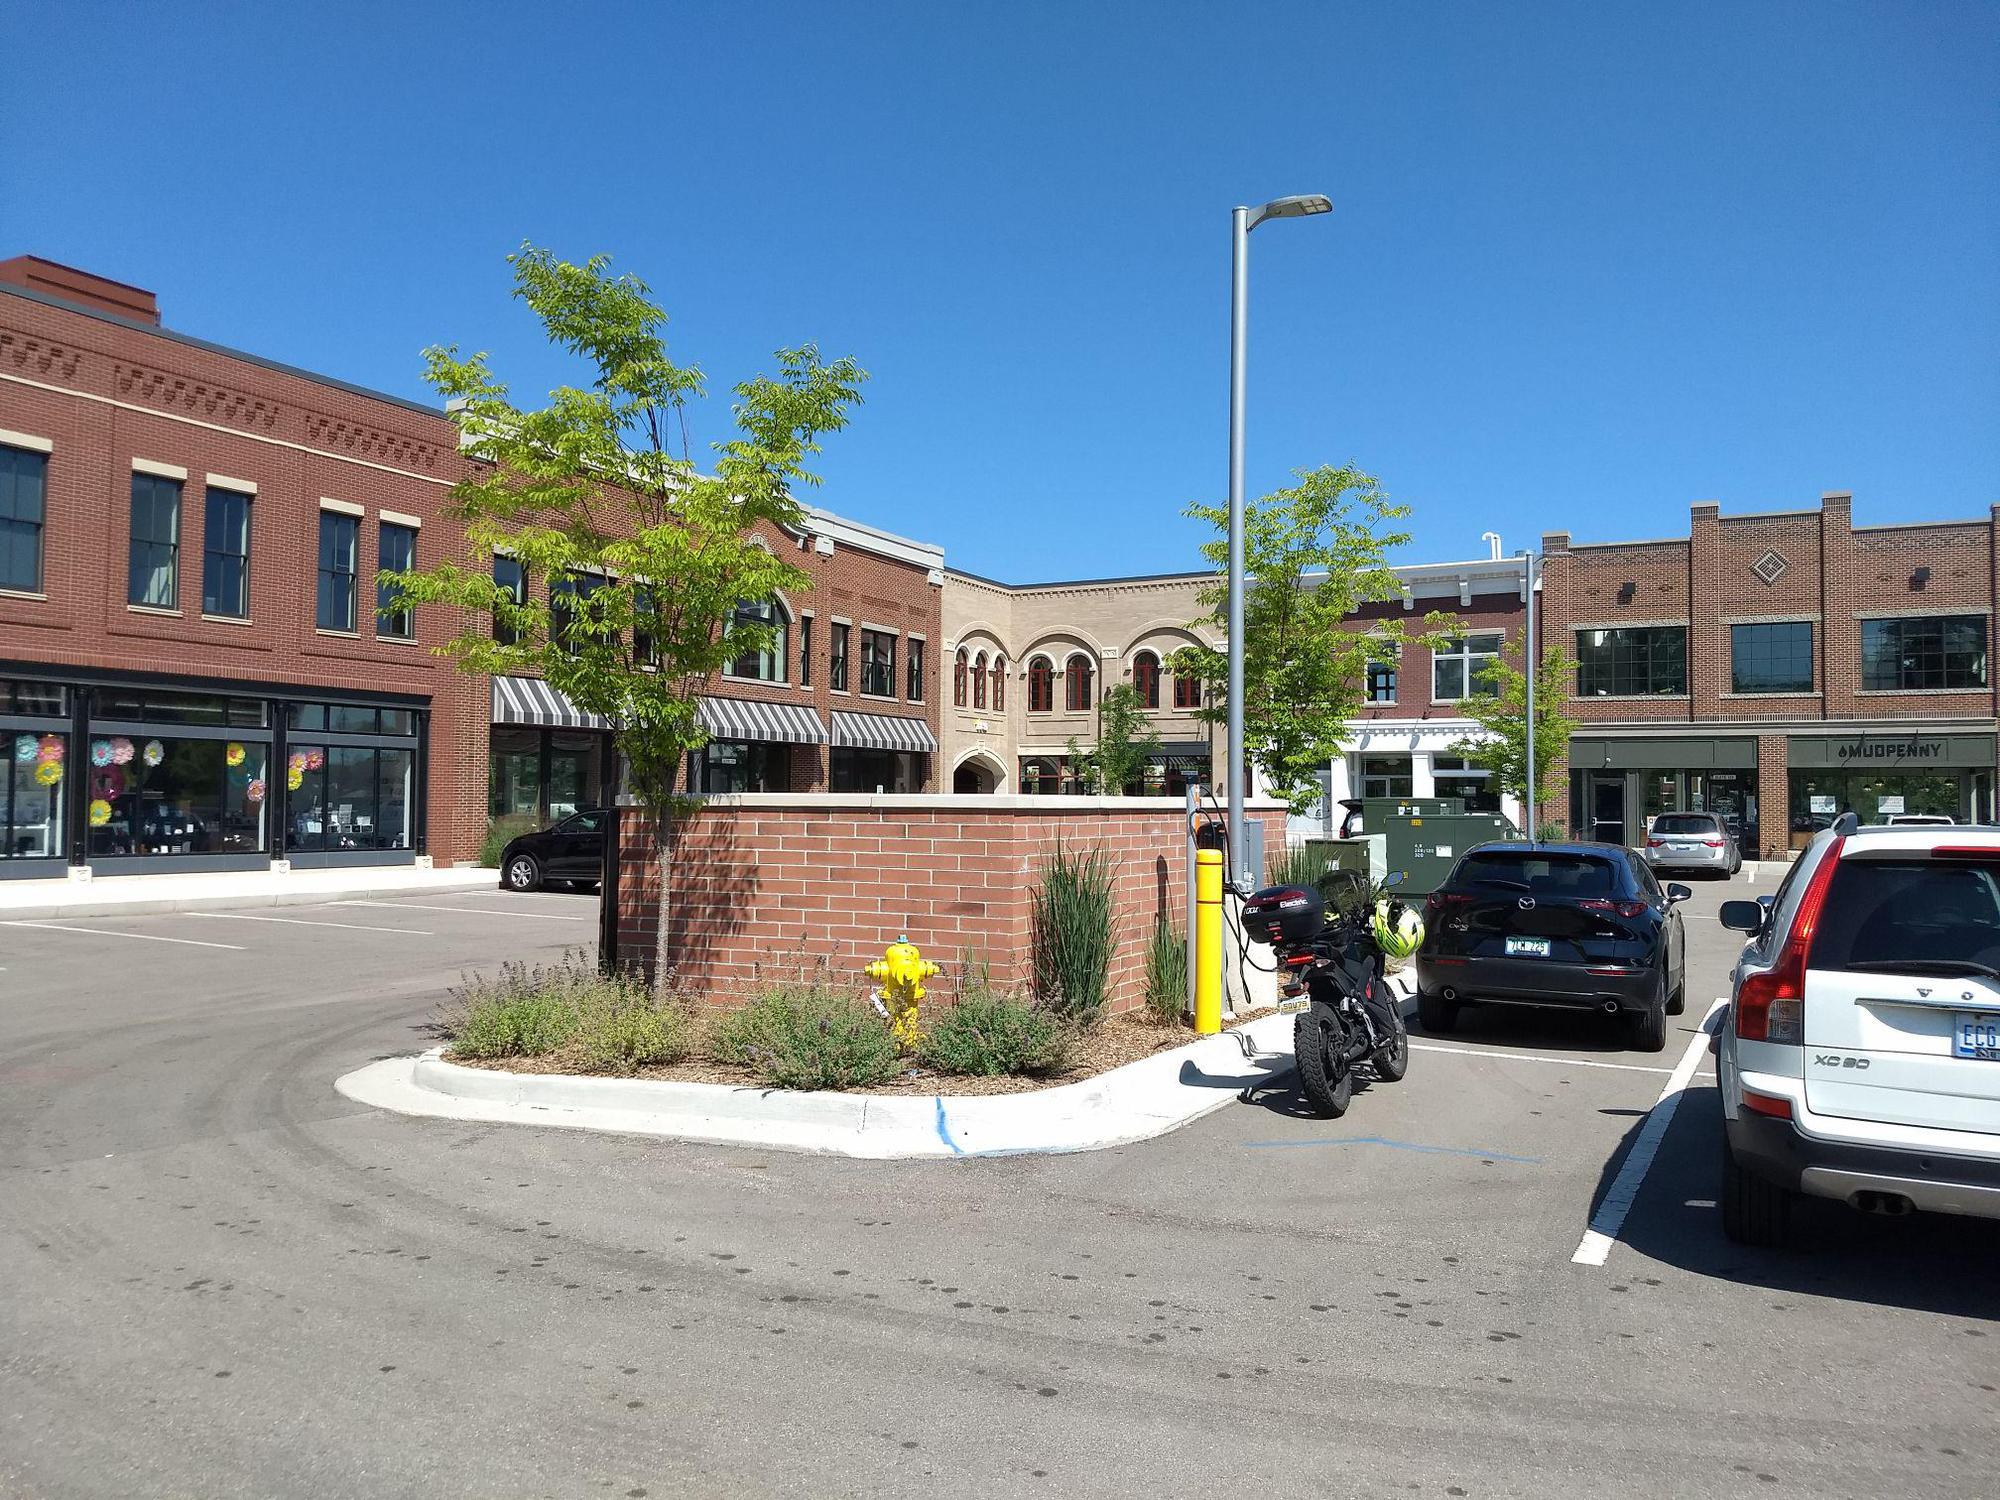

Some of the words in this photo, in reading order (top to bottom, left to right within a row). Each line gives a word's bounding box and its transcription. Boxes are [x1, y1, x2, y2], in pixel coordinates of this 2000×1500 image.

[1848, 743, 1942, 758] MUDPENNY
[1280, 899, 1309, 909] Electric
[1964, 1024, 1996, 1047] ECG
